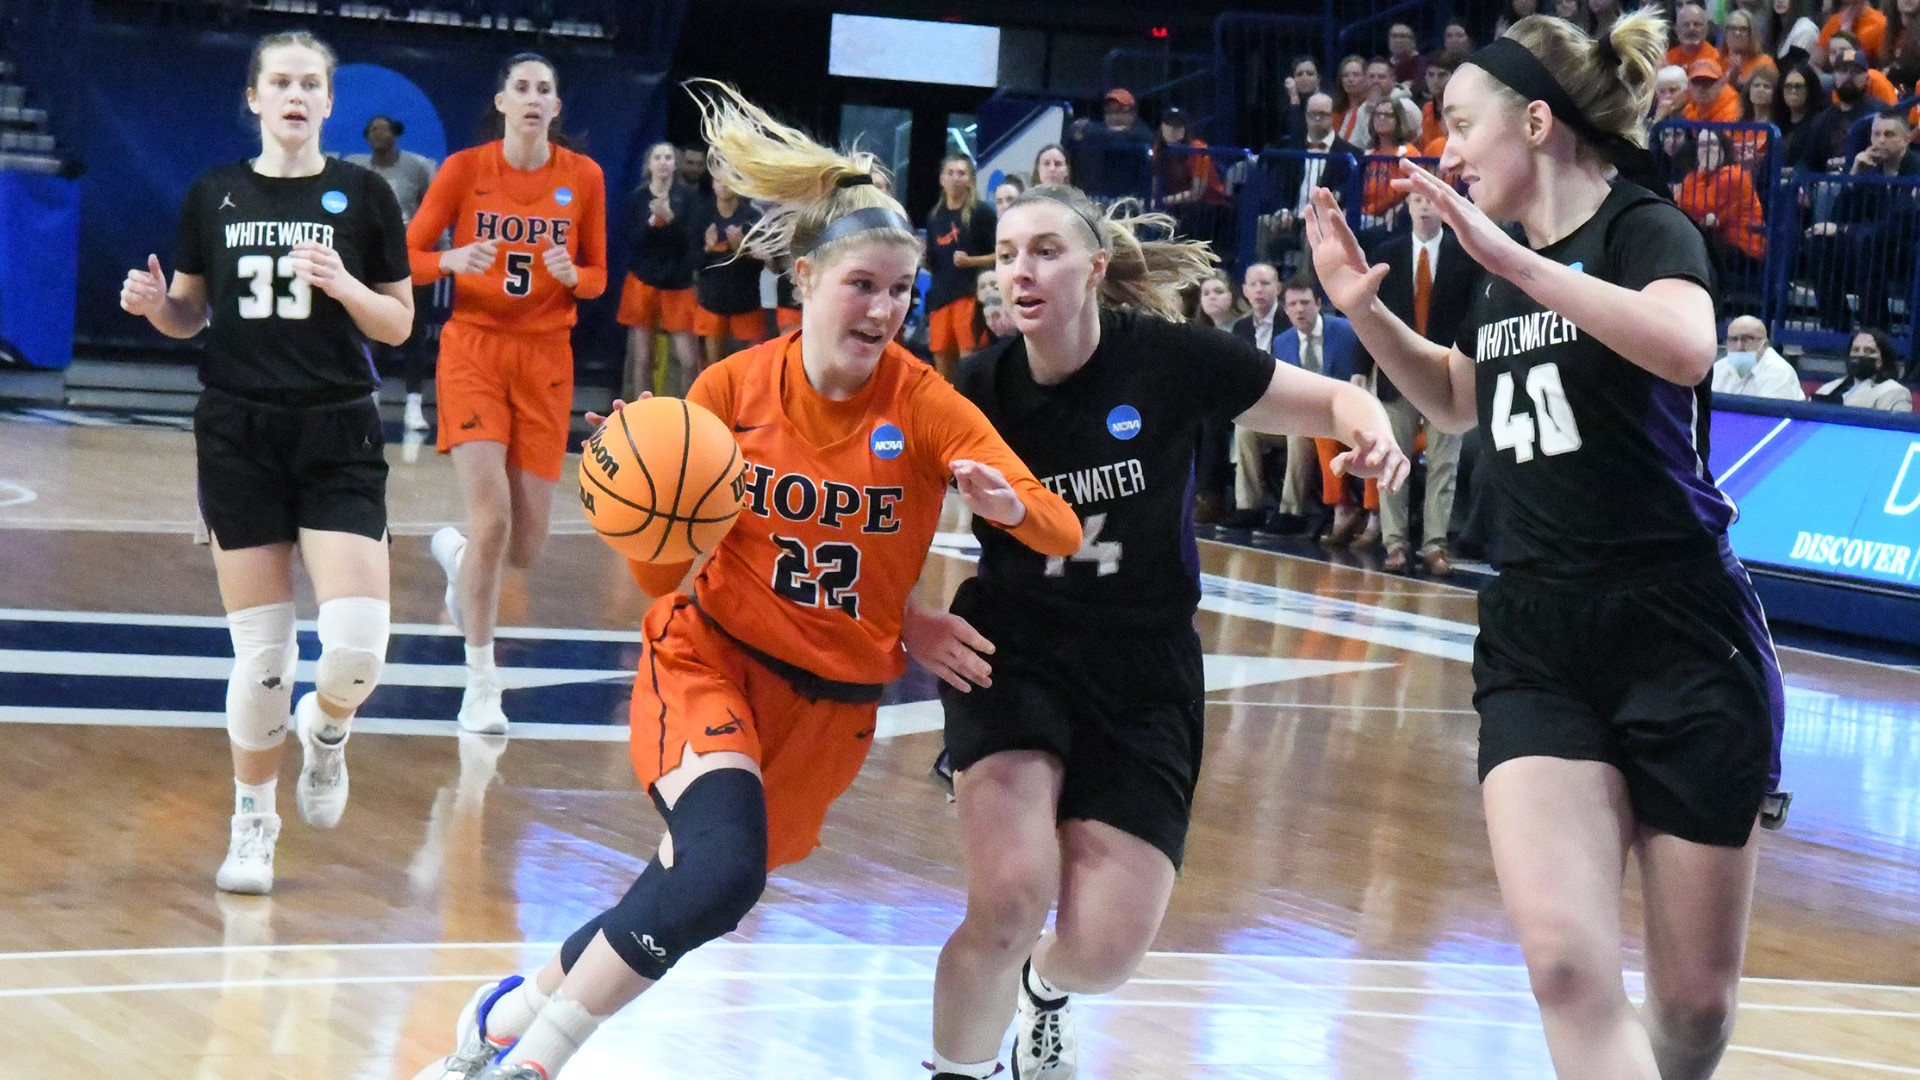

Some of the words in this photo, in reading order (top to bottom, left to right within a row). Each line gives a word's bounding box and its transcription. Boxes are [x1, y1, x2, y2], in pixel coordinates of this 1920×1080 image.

[225, 221, 334, 249] WHITEWATER
[475, 210, 571, 246] HOPE
[237, 254, 312, 320] 33
[504, 251, 533, 297] 5
[1476, 310, 1578, 363] WHITEWATER
[1112, 419, 1140, 432] NCAA
[1491, 362, 1583, 464] 40
[874, 440, 904, 451] NCAA
[743, 460, 903, 534] HOPE
[1041, 458, 1146, 507] TEWATER
[769, 532, 861, 620] 22
[1789, 530, 1911, 575] DISCOVER
